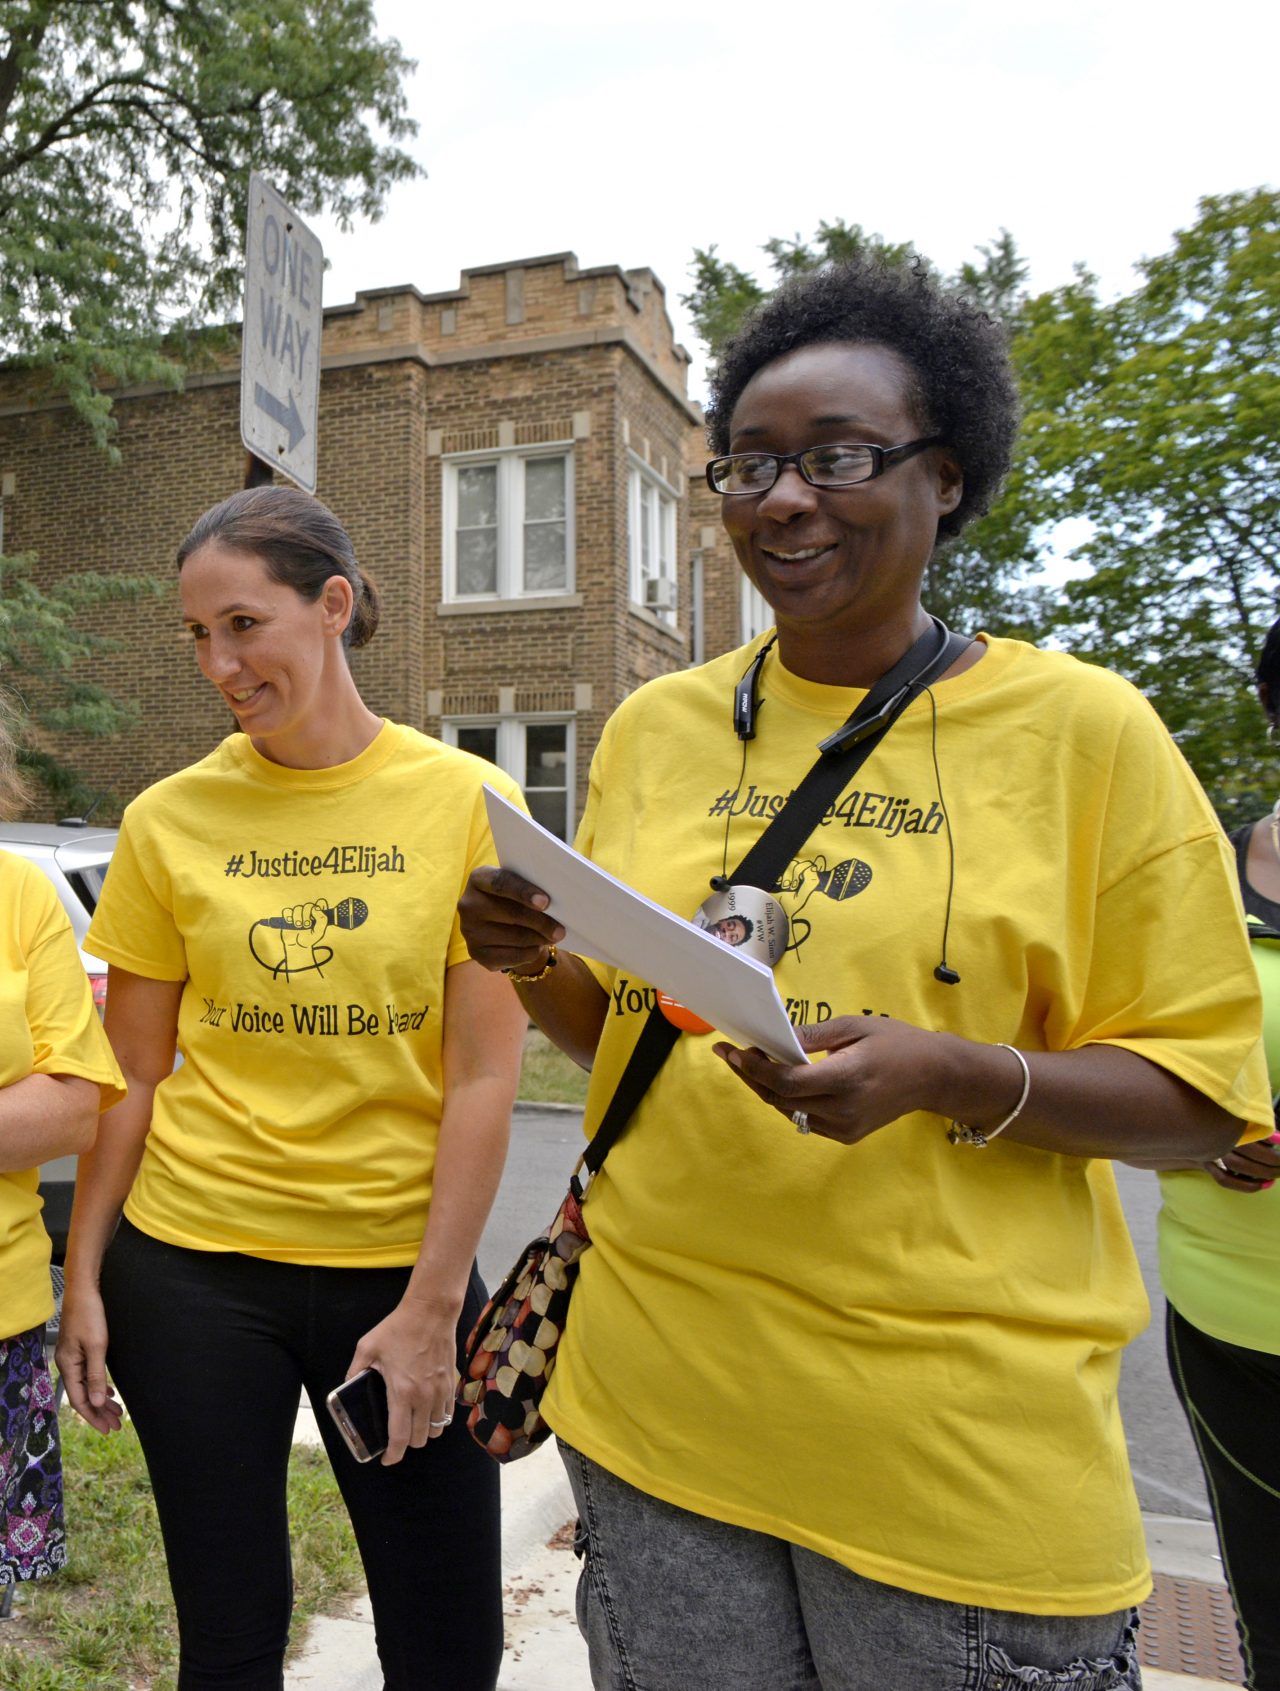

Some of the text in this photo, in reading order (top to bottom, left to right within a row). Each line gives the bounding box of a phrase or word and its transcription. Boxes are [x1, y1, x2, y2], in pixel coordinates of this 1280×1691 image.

[262, 214, 313, 311] ONE
[259, 287, 311, 381] WAY
[223, 844, 406, 878] #Justice4Elijah
[613, 979, 657, 1016] You
[229, 1003, 284, 1034] Voice
[291, 1004, 339, 1036] Will
[346, 1004, 379, 1036] Be
